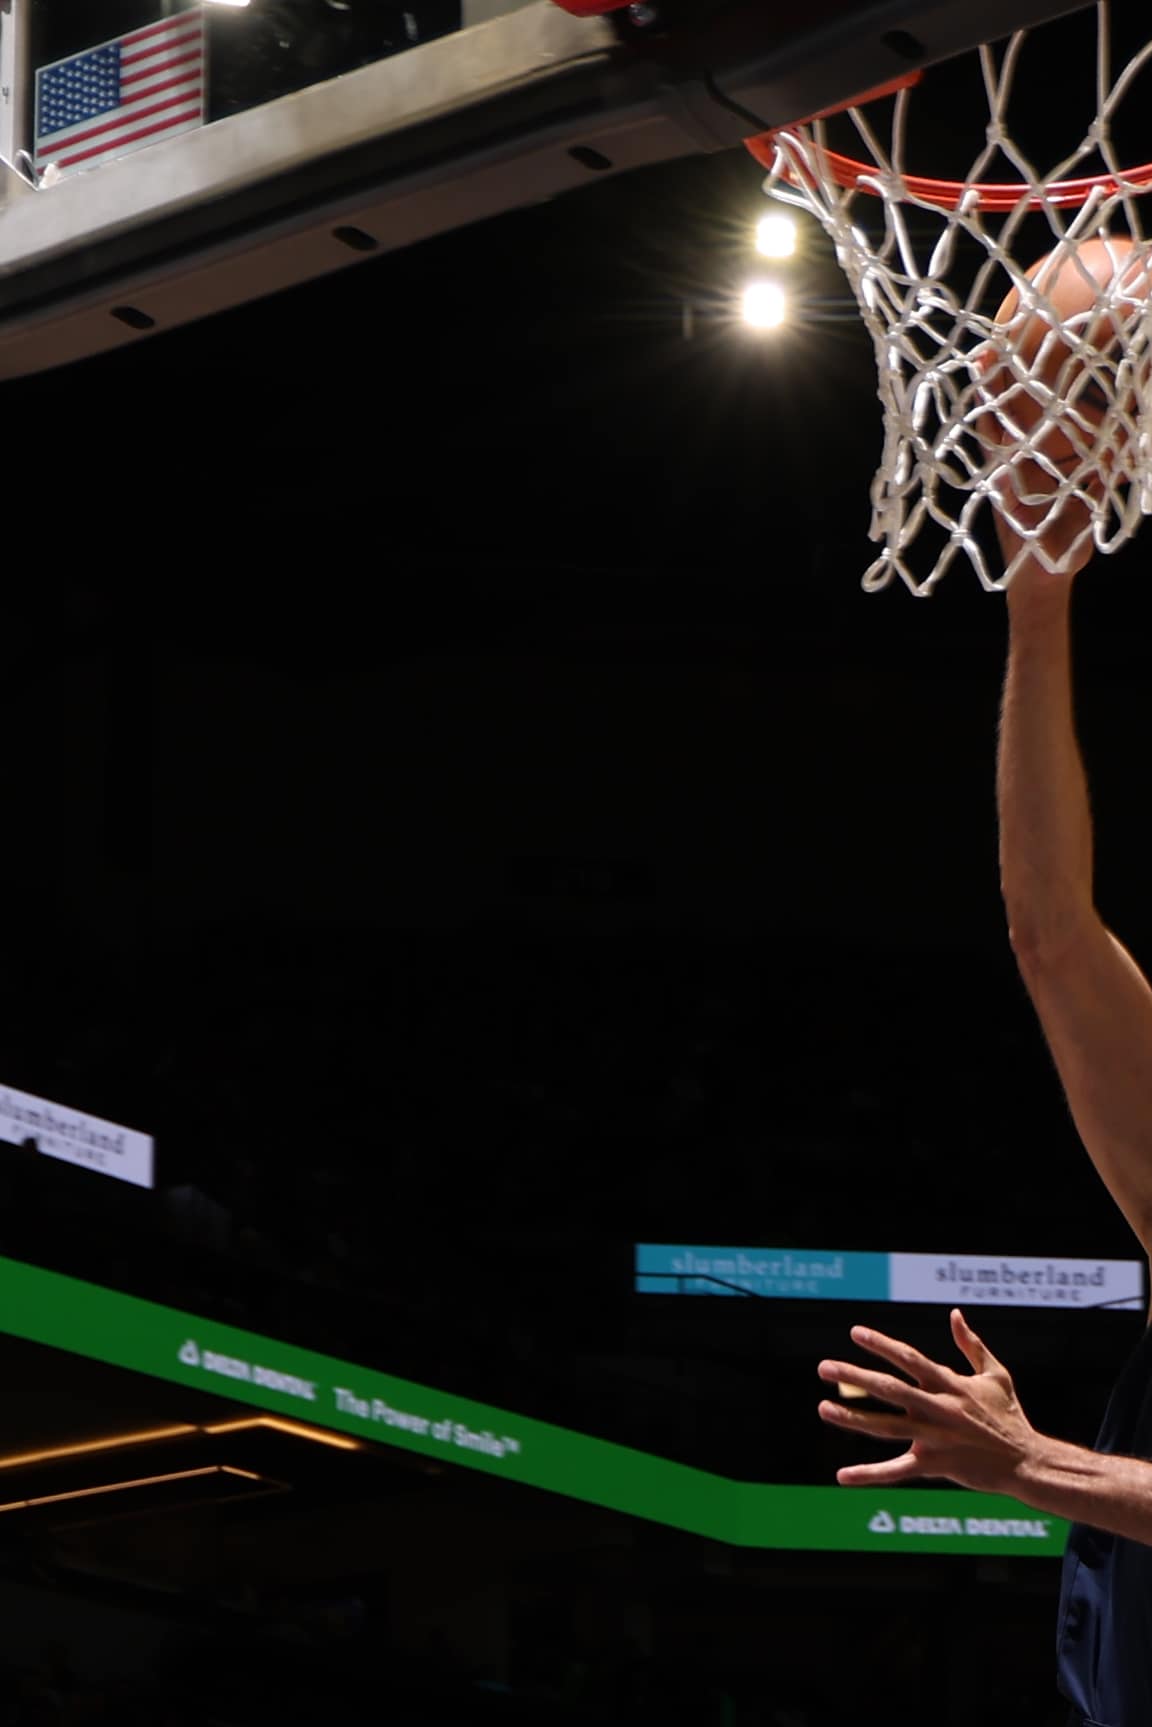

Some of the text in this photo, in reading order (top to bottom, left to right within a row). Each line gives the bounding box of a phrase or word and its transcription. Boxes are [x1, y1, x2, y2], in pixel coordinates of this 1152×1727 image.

[672, 1251, 843, 1278] slumberland
[936, 1262, 1104, 1287] slumberland
[961, 1286, 1081, 1300] FURNITURE
[334, 1387, 370, 1419] The
[371, 1397, 431, 1436] Power
[431, 1419, 453, 1442] of
[900, 1515, 963, 1535] DELTA
